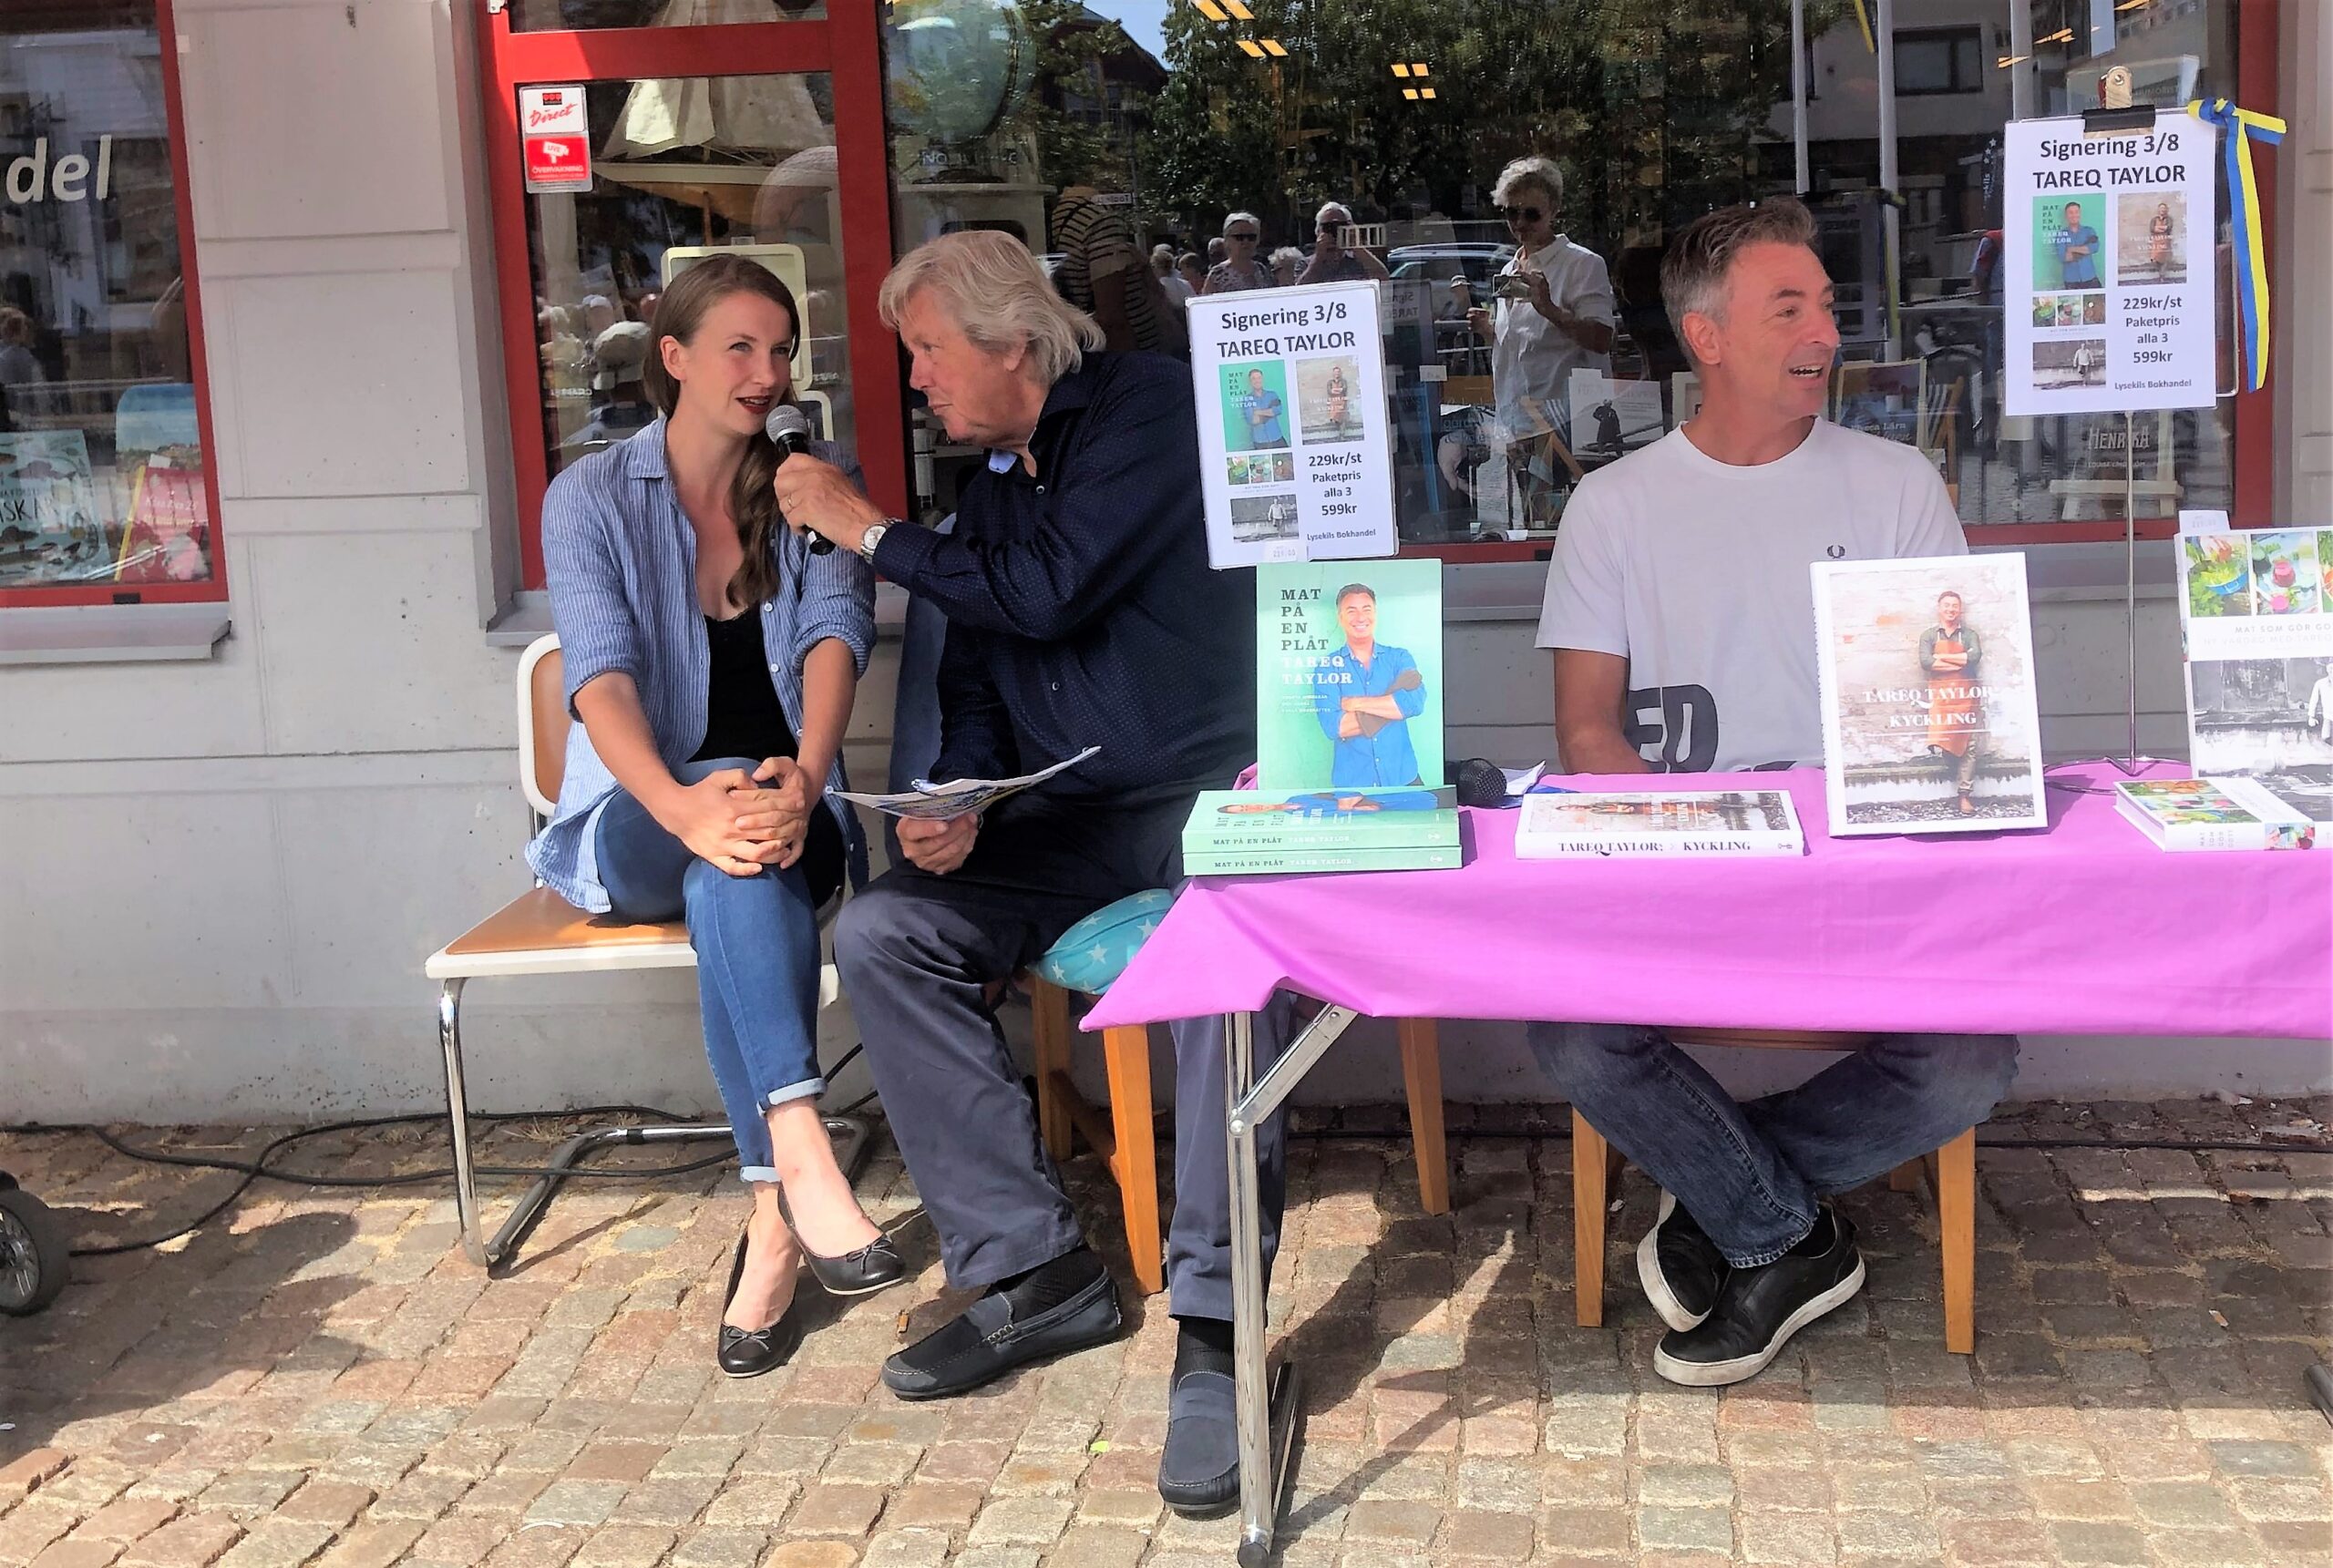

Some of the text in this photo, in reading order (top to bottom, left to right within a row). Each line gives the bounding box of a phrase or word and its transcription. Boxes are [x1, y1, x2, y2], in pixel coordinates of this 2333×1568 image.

[529, 103, 578, 127] Direct
[2040, 133, 2179, 160] Signering 3/8
[6, 135, 112, 204] del
[2033, 164, 2185, 189] TAREQ TAYLOR
[2122, 295, 2183, 311] 229kr/st
[1221, 302, 1347, 332] Signering 3/8
[2125, 315, 2181, 329] Paketpris
[1217, 331, 1356, 358] TAREQ TAYLOR
[2137, 332, 2169, 343] alla 3
[2133, 350, 2173, 364] 599kr
[2114, 378, 2192, 390] Lysekils Bokhandel
[1309, 452, 1362, 467] 229kr/st
[1312, 470, 1362, 484] Paketpris
[1323, 487, 1352, 498] alla 3
[1321, 503, 1358, 516] 599kr
[1307, 528, 1376, 541] Lysekils Bokhandel
[1281, 589, 1321, 600] MAT
[1281, 601, 1305, 618] PÅ
[1281, 622, 1307, 635] EN
[2288, 623, 2310, 631] GÖR
[1281, 635, 1330, 651] PLÅT
[1281, 655, 1345, 669] TAREQ
[1282, 672, 1353, 685] TAYLOR
[1863, 686, 1992, 708] TAREQ TAYLOR
[1889, 712, 1977, 727] KYCKLING
[1559, 842, 1611, 856] TAREQ
[1683, 842, 1751, 851] KYCKLING
